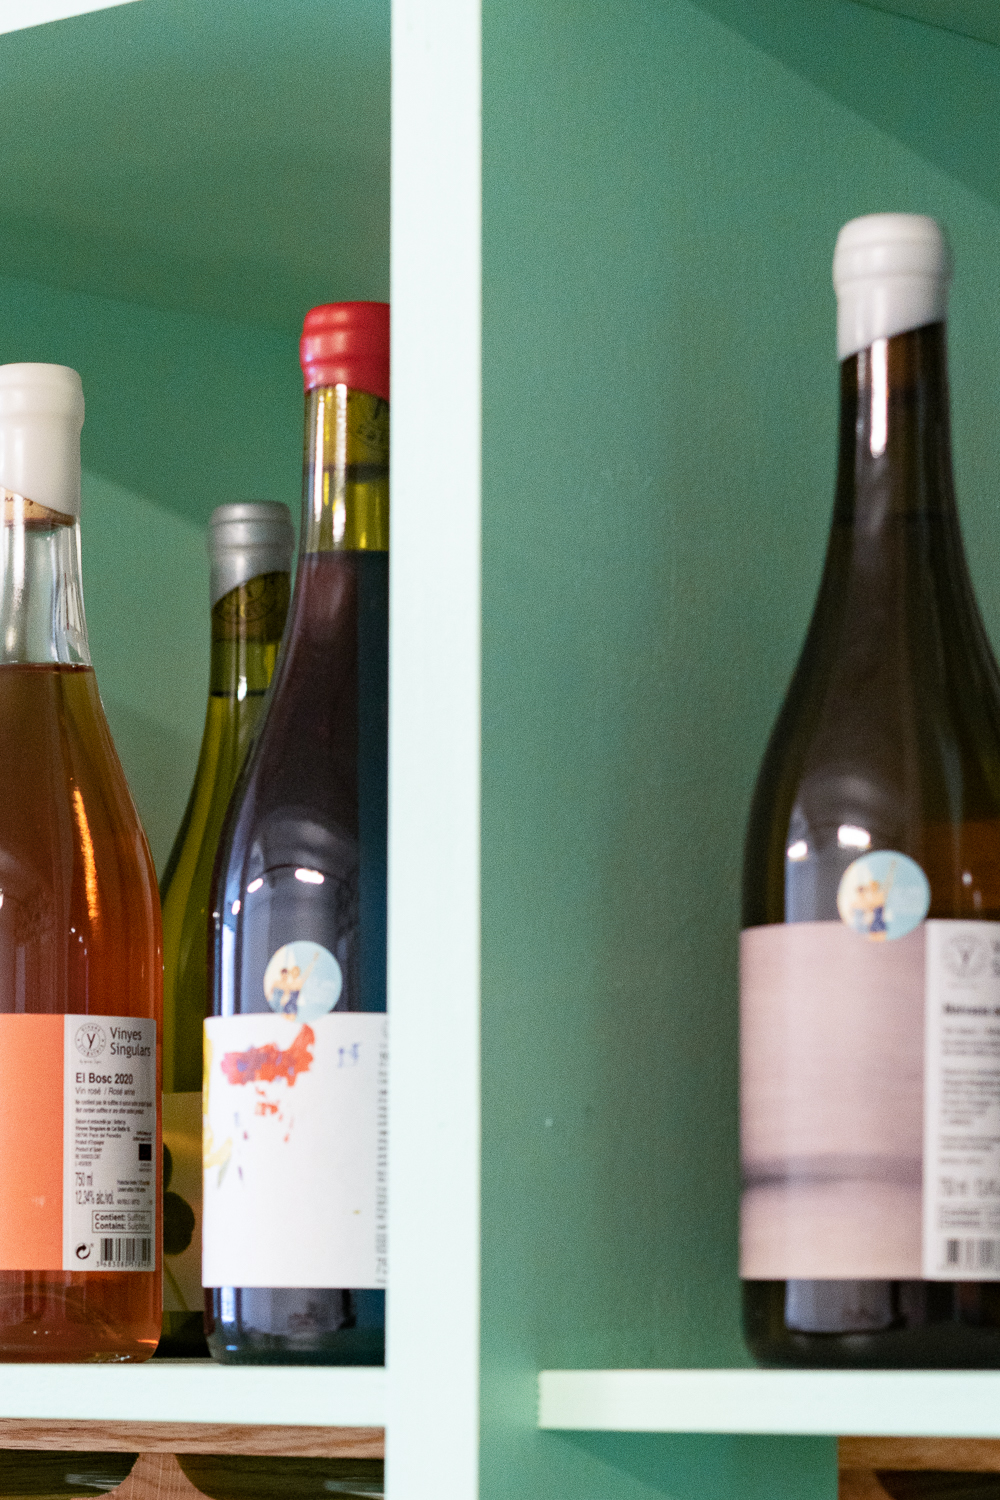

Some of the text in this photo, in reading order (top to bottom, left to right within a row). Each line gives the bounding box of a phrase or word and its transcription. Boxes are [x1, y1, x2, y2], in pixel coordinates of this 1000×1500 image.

[110, 1026, 142, 1043] Vinyes
[110, 1042, 151, 1058] Singulars
[76, 1072, 134, 1085] El Bosc 2020
[95, 1213, 125, 1221] Contient:
[95, 1222, 126, 1230] Contains:
